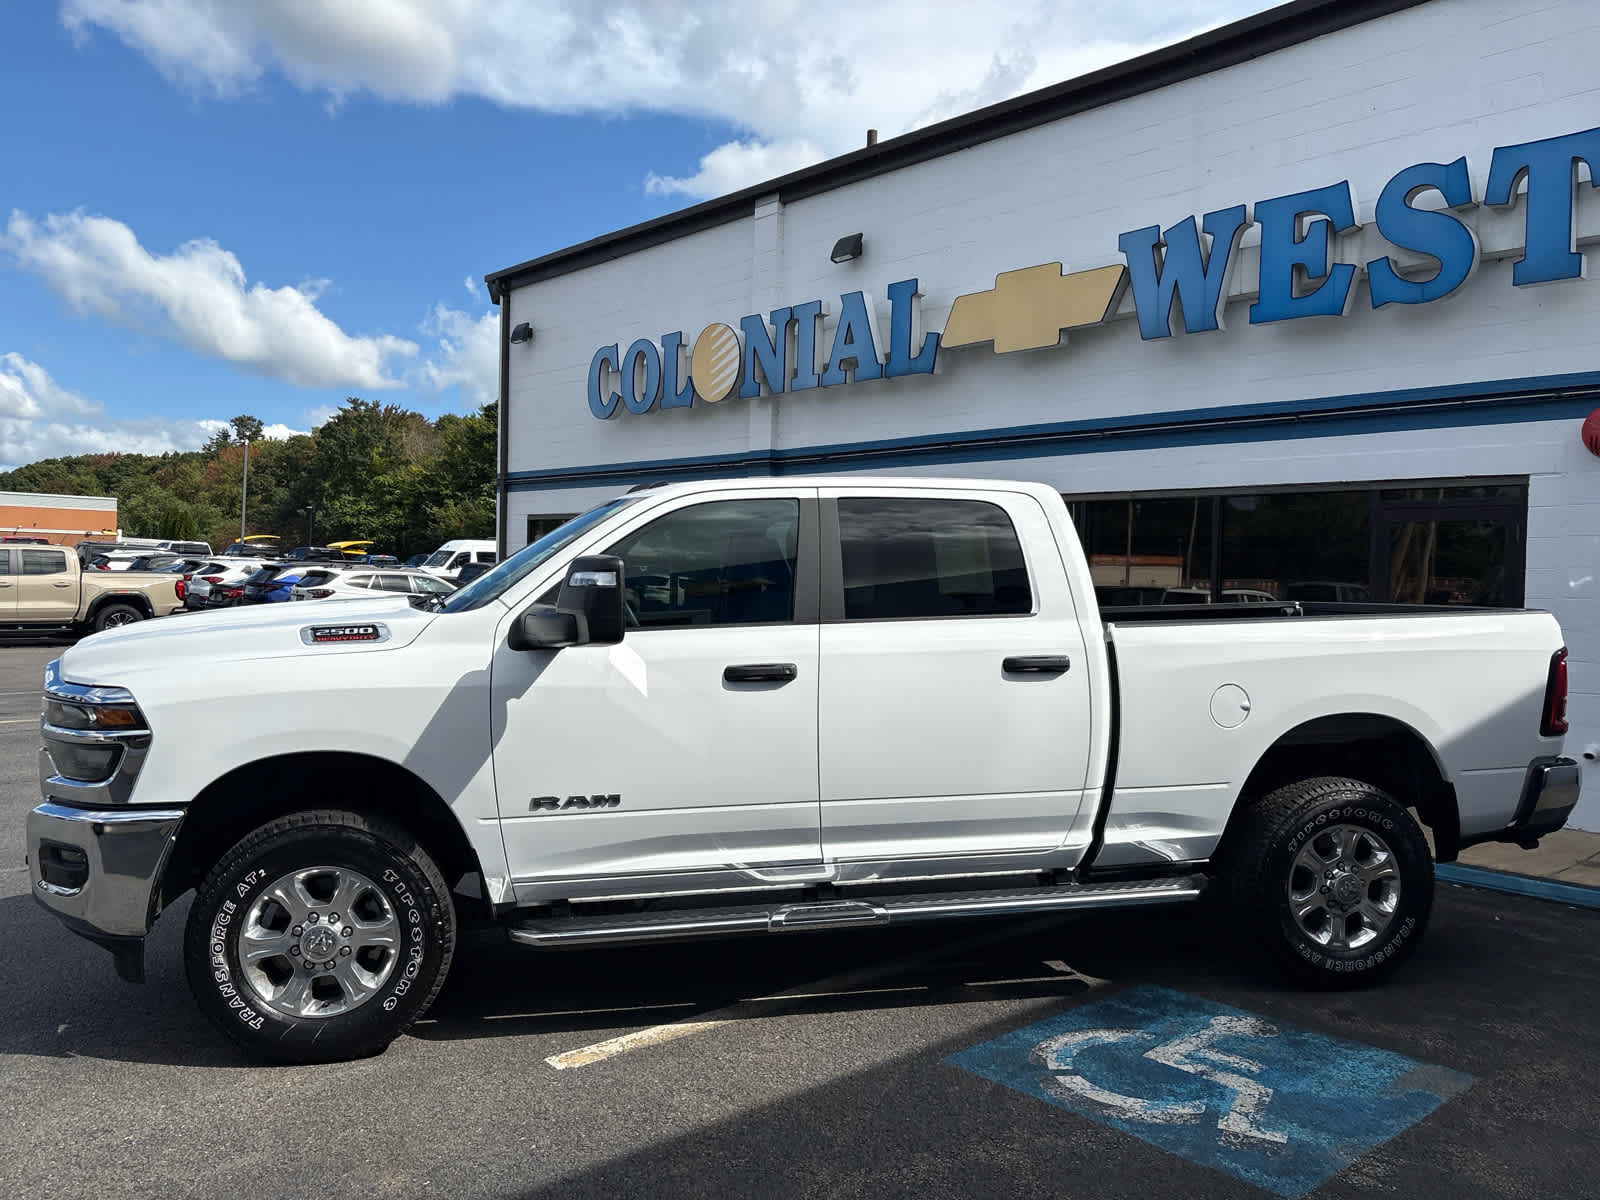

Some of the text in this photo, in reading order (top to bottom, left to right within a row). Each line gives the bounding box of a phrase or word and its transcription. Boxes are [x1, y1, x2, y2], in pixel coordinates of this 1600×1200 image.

[1118, 126, 1600, 341] WEST
[315, 627, 374, 636] 2500
[528, 794, 621, 812] RAM
[211, 899, 265, 1031] TRANSFORCE
